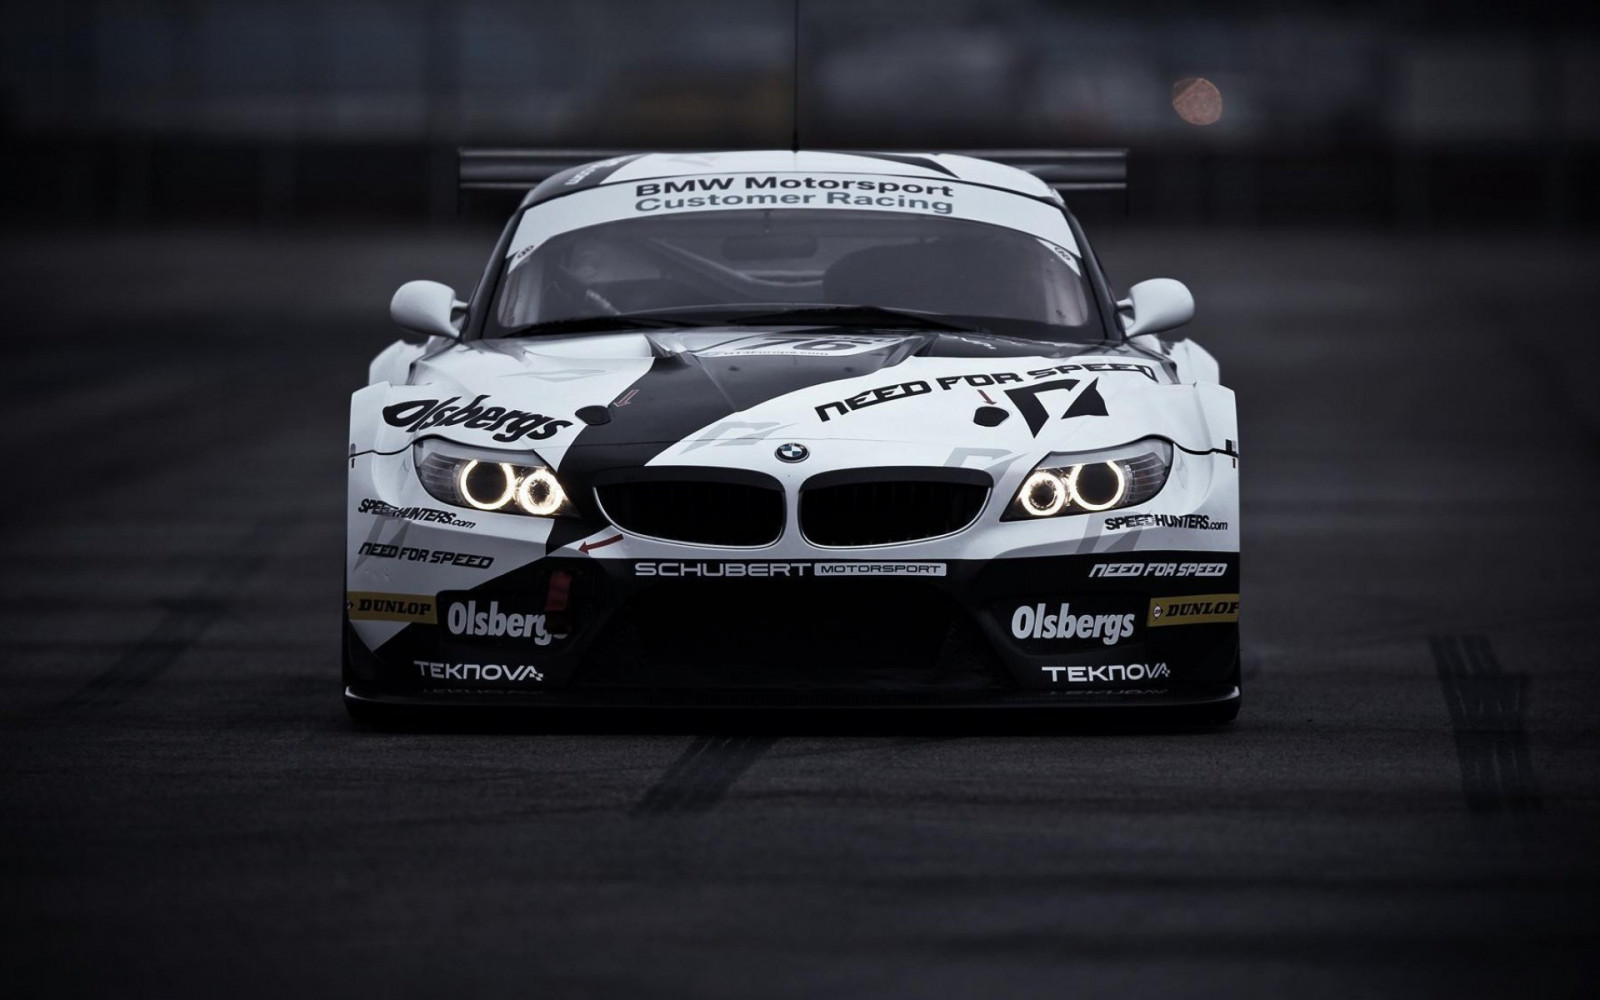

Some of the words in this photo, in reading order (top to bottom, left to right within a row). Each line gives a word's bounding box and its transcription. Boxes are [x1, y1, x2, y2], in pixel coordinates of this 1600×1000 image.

[636, 178, 734, 196] BMW
[745, 176, 954, 197] Motorsport
[635, 192, 815, 212] Customer
[827, 191, 953, 214] Racing
[814, 380, 932, 422] NEED
[936, 372, 1024, 391] FOR
[1026, 363, 1159, 383] SPEED
[382, 394, 573, 442] Olsbergs
[358, 542, 400, 559] NEED
[398, 547, 430, 562] FOR
[429, 550, 495, 570] SPEED
[635, 562, 812, 577] SCHUBERT
[819, 564, 941, 575] MOTORSPORT
[1088, 562, 1145, 578] NEED
[1143, 562, 1178, 577] FOR
[1175, 562, 1228, 577] SPEED
[358, 598, 431, 616] DUNLOP
[447, 600, 568, 646] Olsberg
[1011, 602, 1136, 646] Olsbergs
[413, 660, 544, 682] TEKNOVA
[1041, 662, 1171, 683] TEKNOVA
